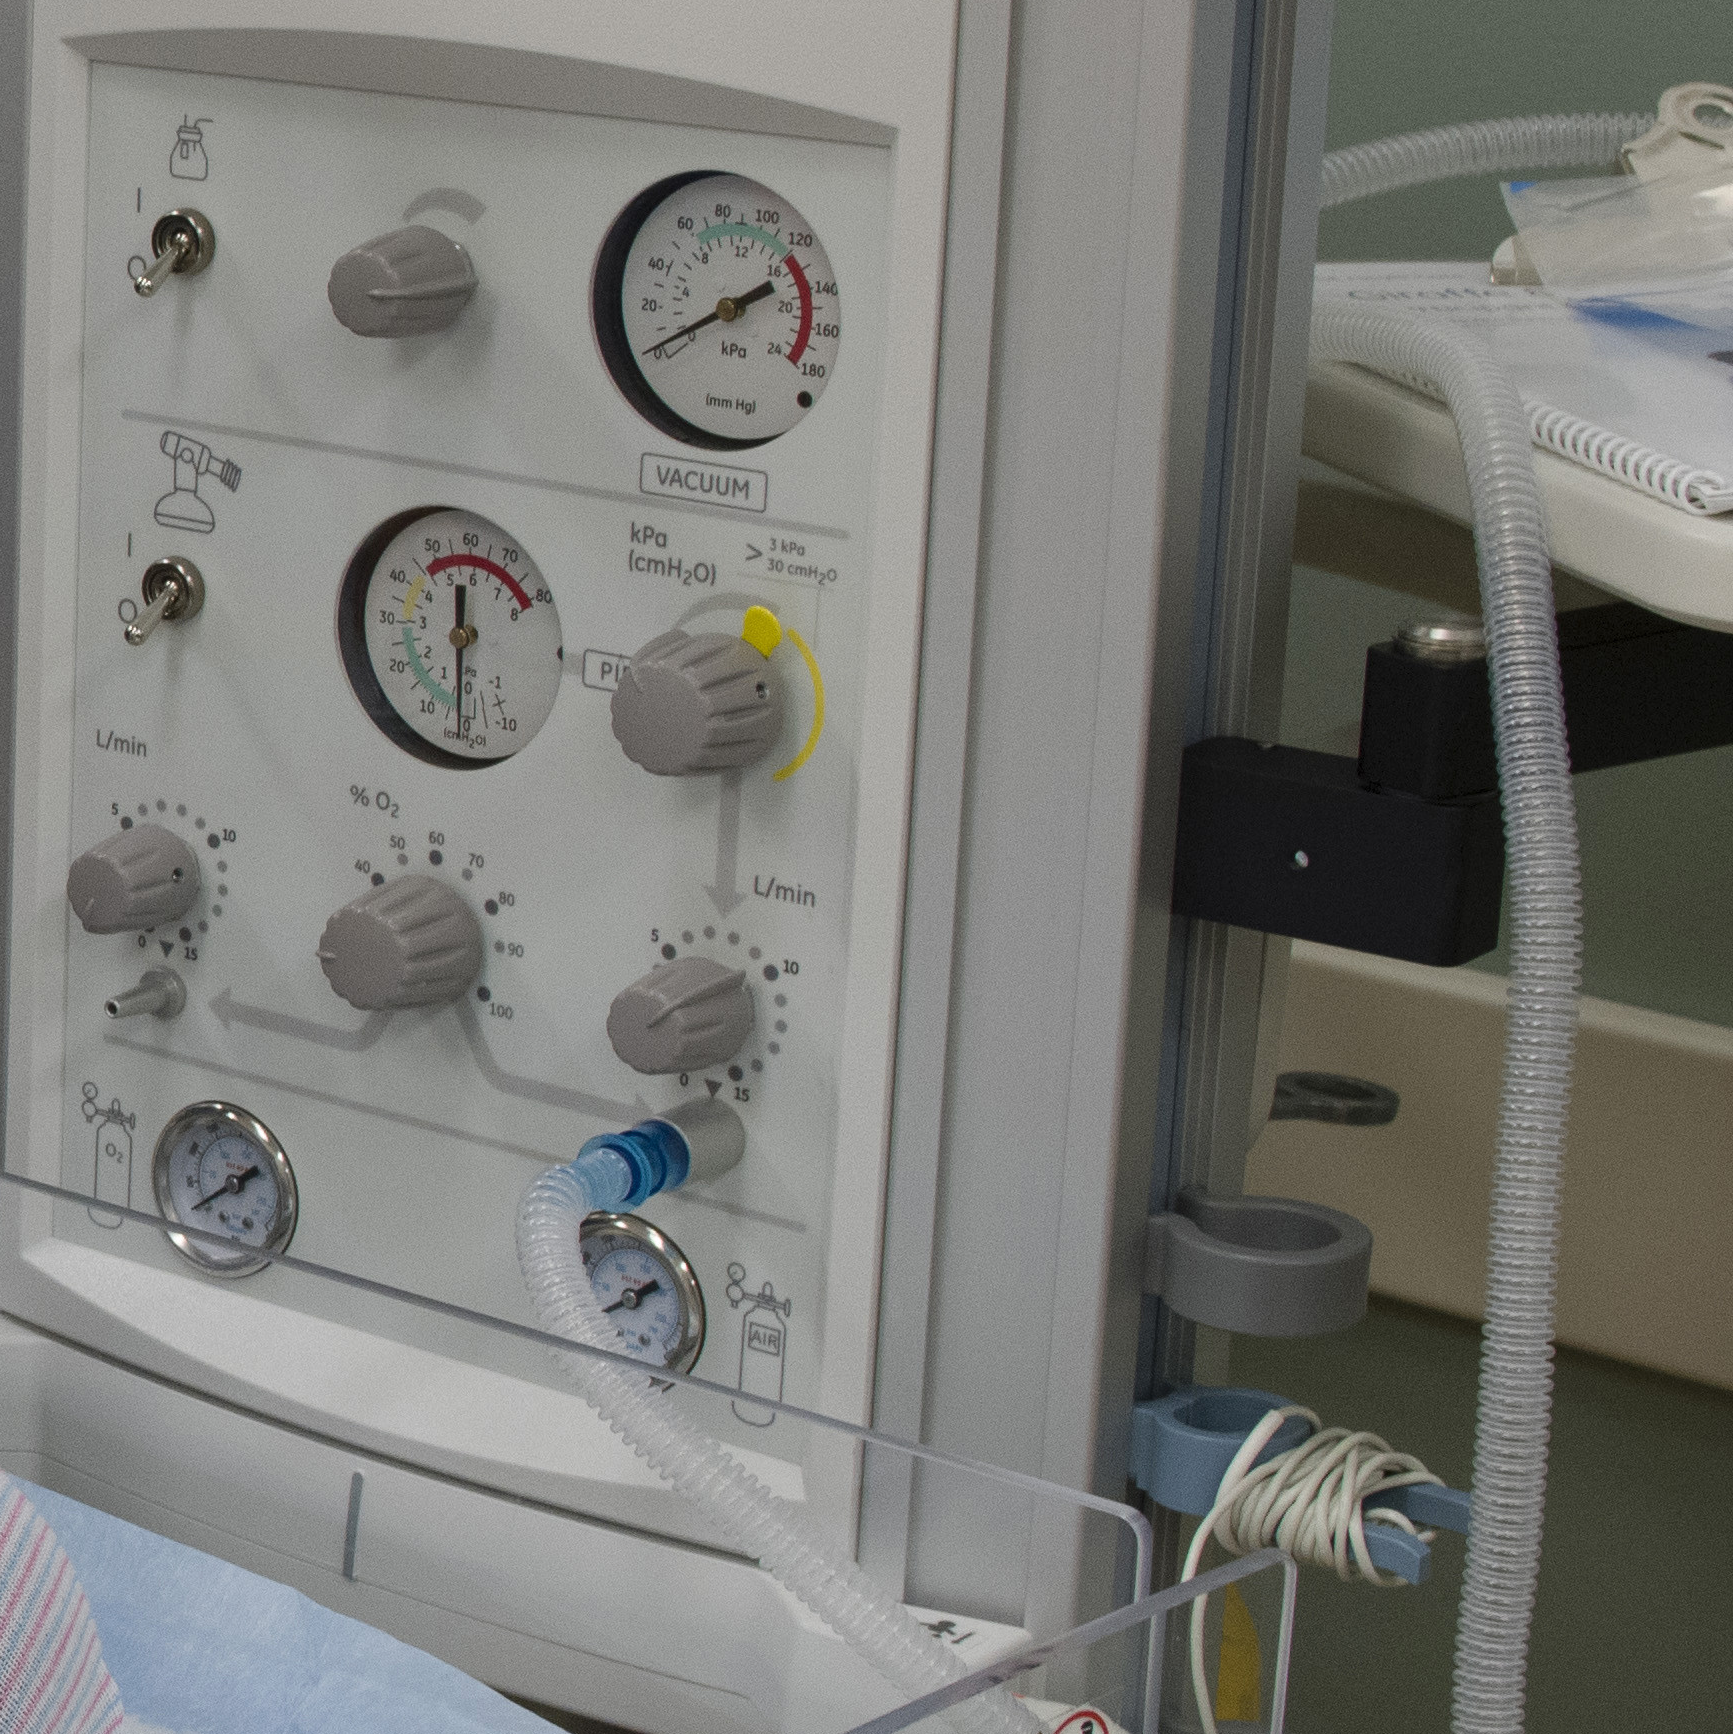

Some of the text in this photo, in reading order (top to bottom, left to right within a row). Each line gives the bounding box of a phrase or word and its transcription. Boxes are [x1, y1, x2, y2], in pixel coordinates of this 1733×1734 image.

[720, 340, 747, 360] kPa
[705, 392, 758, 415] (mm Hg)
[656, 464, 751, 500] VACUUM
[630, 520, 668, 548] kPa
[767, 558, 784, 573] 30
[96, 728, 148, 758] L/min
[349, 784, 370, 807] %
[390, 835, 406, 850] 50
[428, 831, 445, 846] 60
[354, 859, 371, 874] 40
[468, 853, 485, 868] 70
[498, 891, 515, 907] 80
[752, 874, 817, 908] L/min
[507, 942, 524, 958] 90
[752, 1331, 779, 1351] AIR
